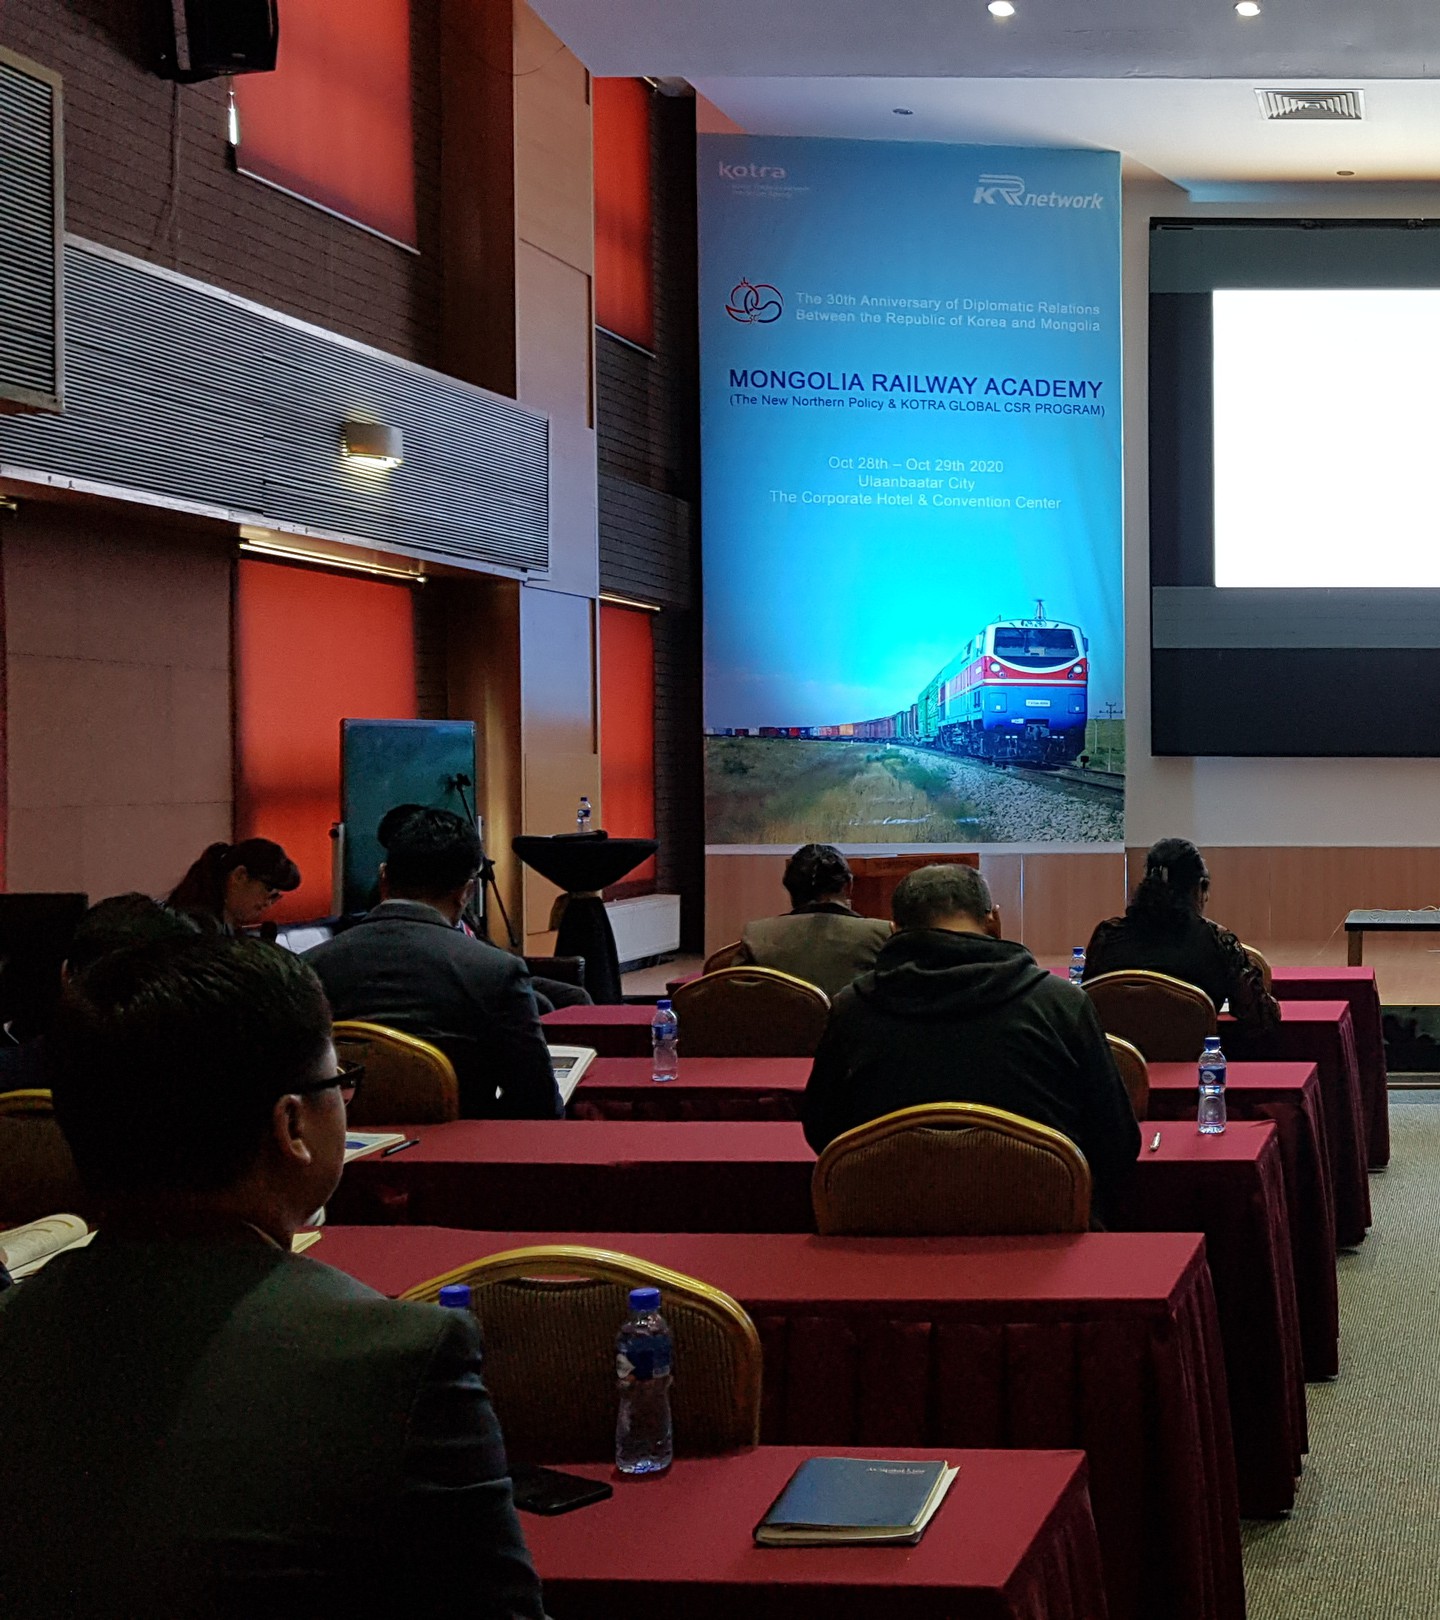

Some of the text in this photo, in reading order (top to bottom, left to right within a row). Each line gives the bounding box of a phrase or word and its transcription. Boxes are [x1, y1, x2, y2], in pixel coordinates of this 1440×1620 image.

[719, 161, 786, 179] kotra
[796, 292, 1100, 315] The 30th Anniversary of Diplomatic Relations
[796, 309, 1100, 332] Between the Republic of Korea and Mongolia
[729, 369, 1103, 399] MONGOLIA RAILWAY ACADEMY
[729, 393, 1105, 417] (The New Northern Policy & KOTRA GLOBAL CSR PROGRAM)
[828, 456, 854, 469] Oct
[858, 457, 888, 469] 28th
[906, 458, 930, 471] Oct
[935, 459, 965, 472] 29th
[970, 460, 1004, 472] 2020
[858, 475, 975, 492] Ulaanbaatar City
[769, 490, 1061, 509] The Corporate Hotel & Convention Center
